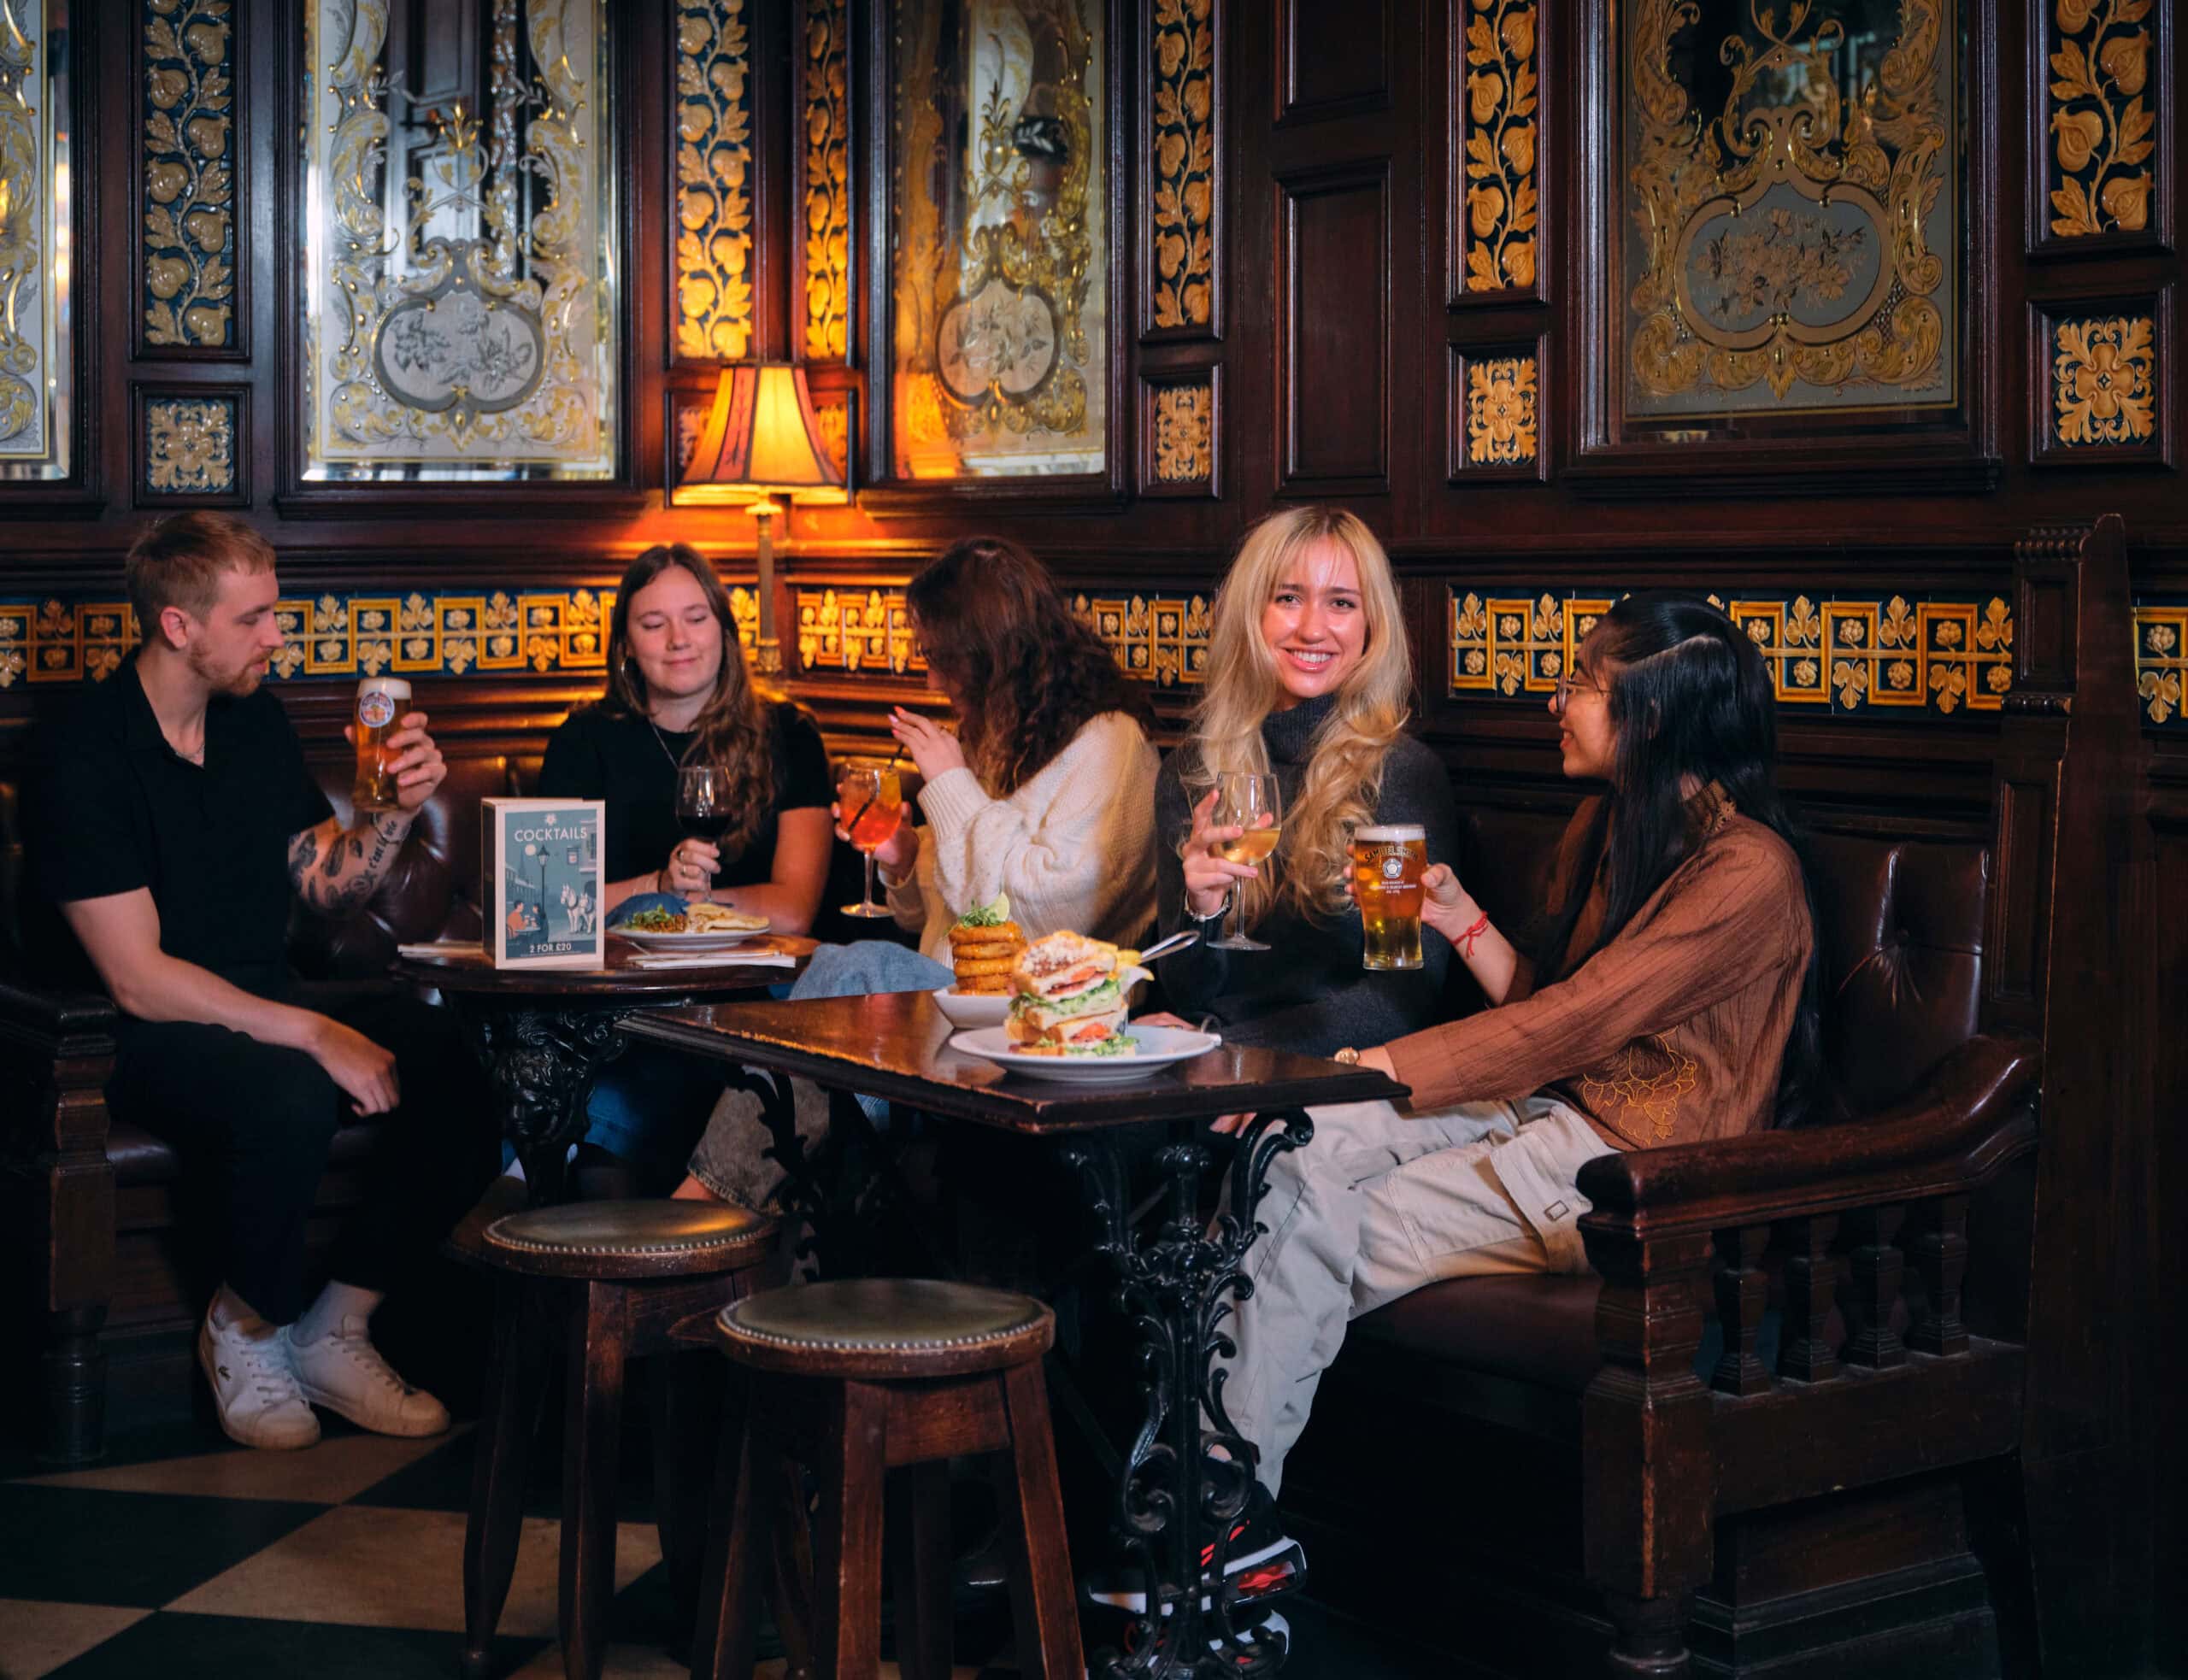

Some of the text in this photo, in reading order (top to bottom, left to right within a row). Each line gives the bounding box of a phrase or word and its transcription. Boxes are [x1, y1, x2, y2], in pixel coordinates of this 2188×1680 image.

[514, 826, 587, 842] COCKTAILS
[529, 943, 572, 954] 2 FOR £20
